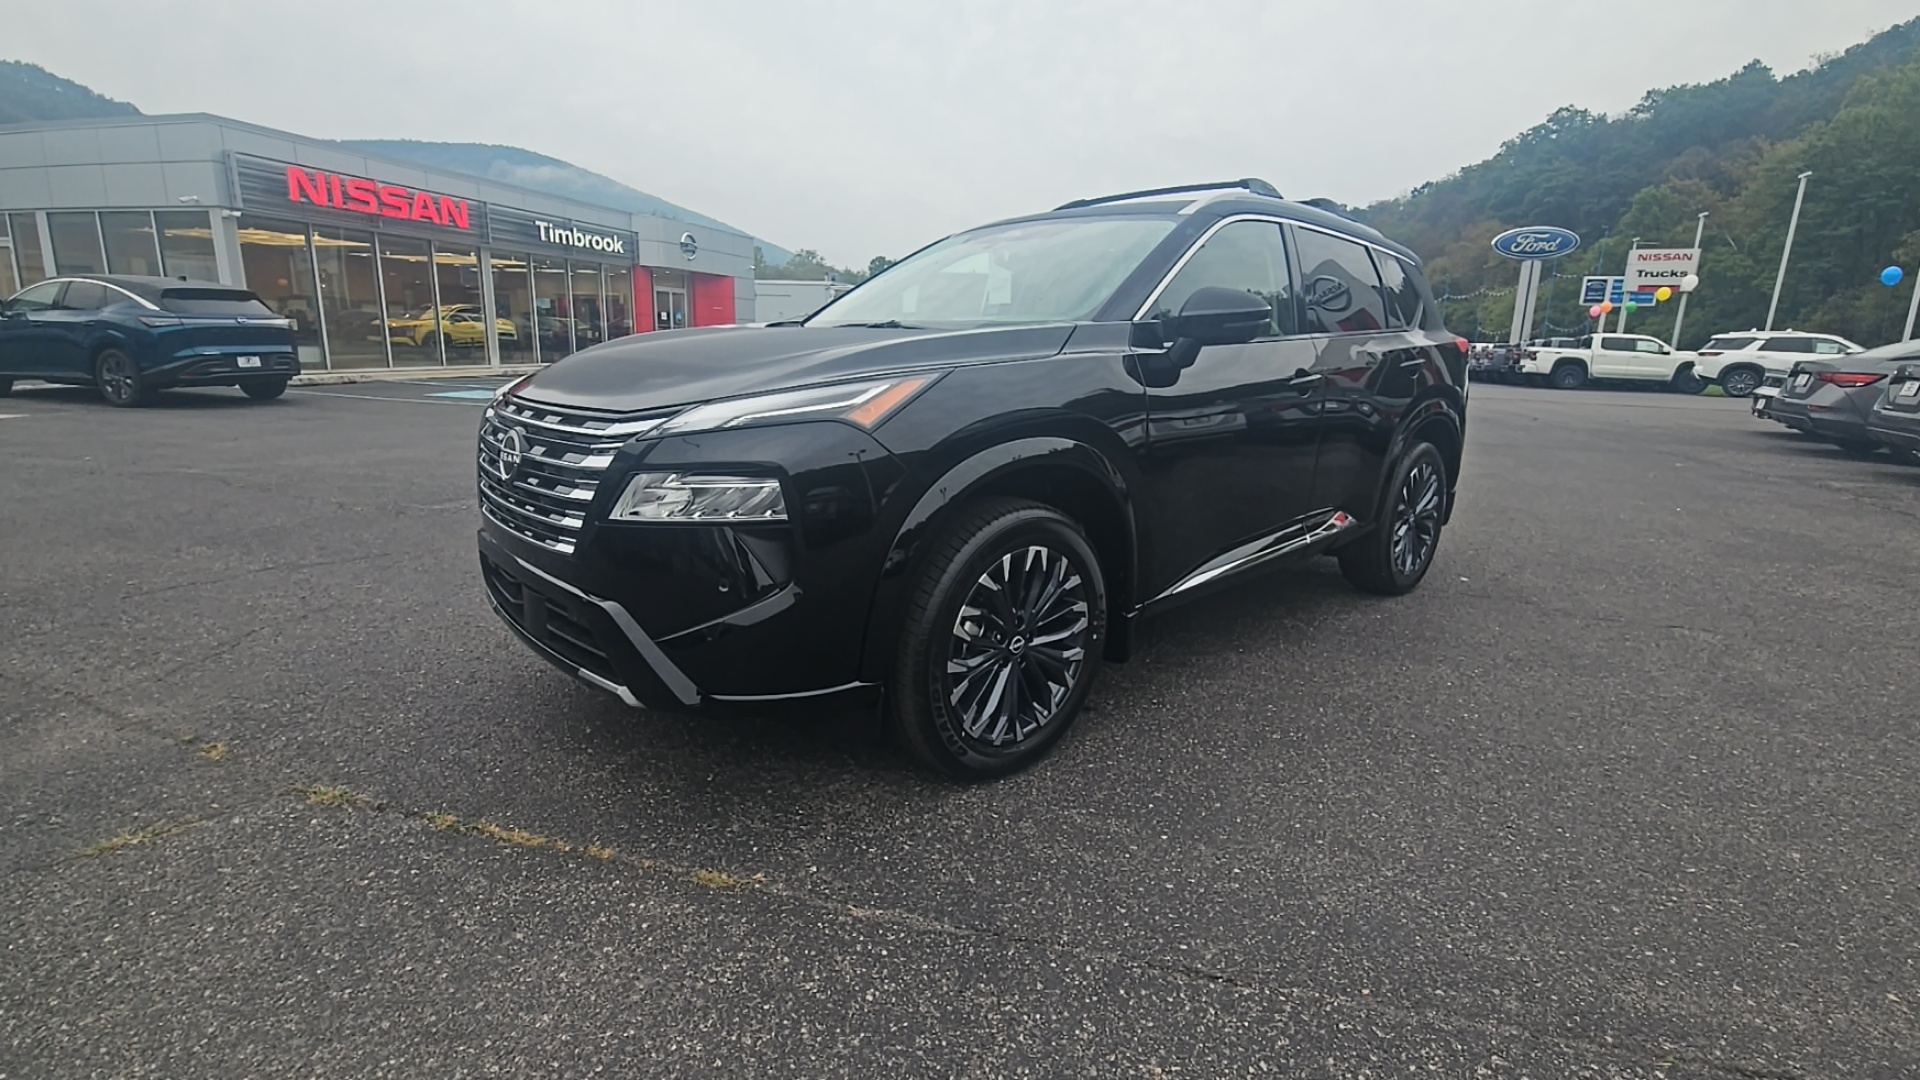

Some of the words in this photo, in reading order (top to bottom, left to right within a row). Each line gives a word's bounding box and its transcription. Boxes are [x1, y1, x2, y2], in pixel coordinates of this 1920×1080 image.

[287, 166, 470, 230] NISSAN
[535, 220, 624, 254] Timbrook
[1511, 233, 1561, 252] Ford
[1637, 253, 1693, 262] NISSAN
[1636, 269, 1688, 278] Trucks
